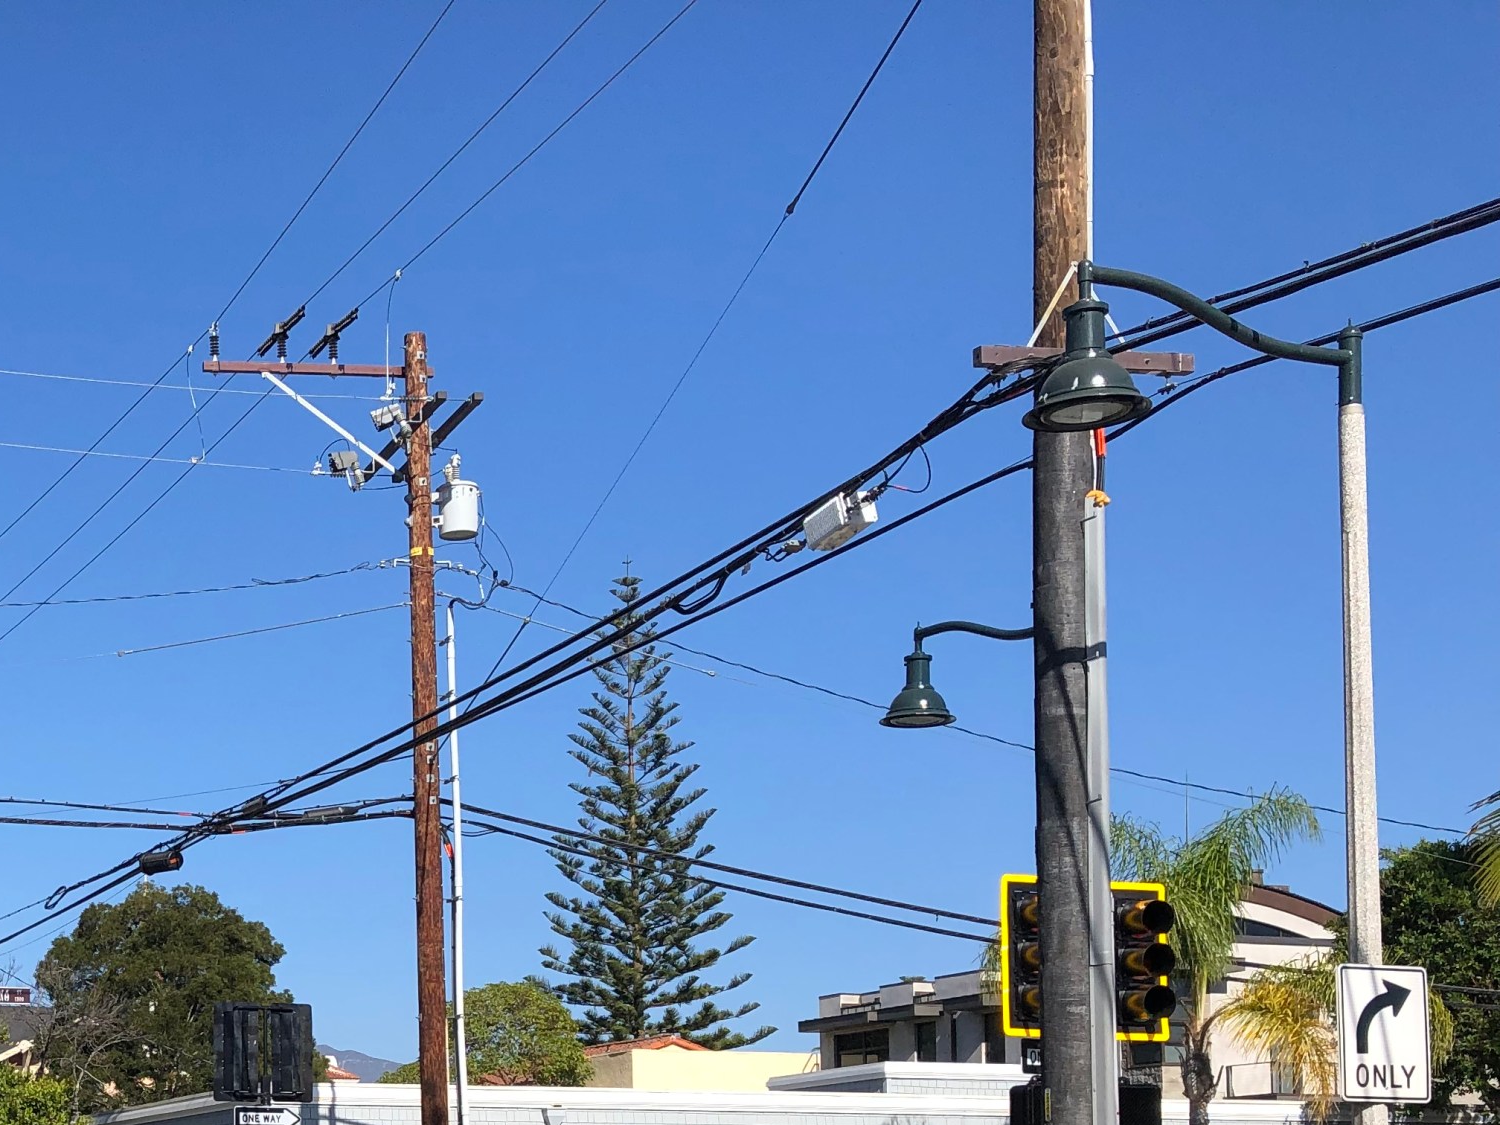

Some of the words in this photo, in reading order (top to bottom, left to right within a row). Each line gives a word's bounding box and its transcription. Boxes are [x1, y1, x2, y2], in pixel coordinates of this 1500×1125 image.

[1356, 1063, 1416, 1089] ONLY
[242, 1114, 260, 1123] ONE
[263, 1115, 282, 1123] WAY
